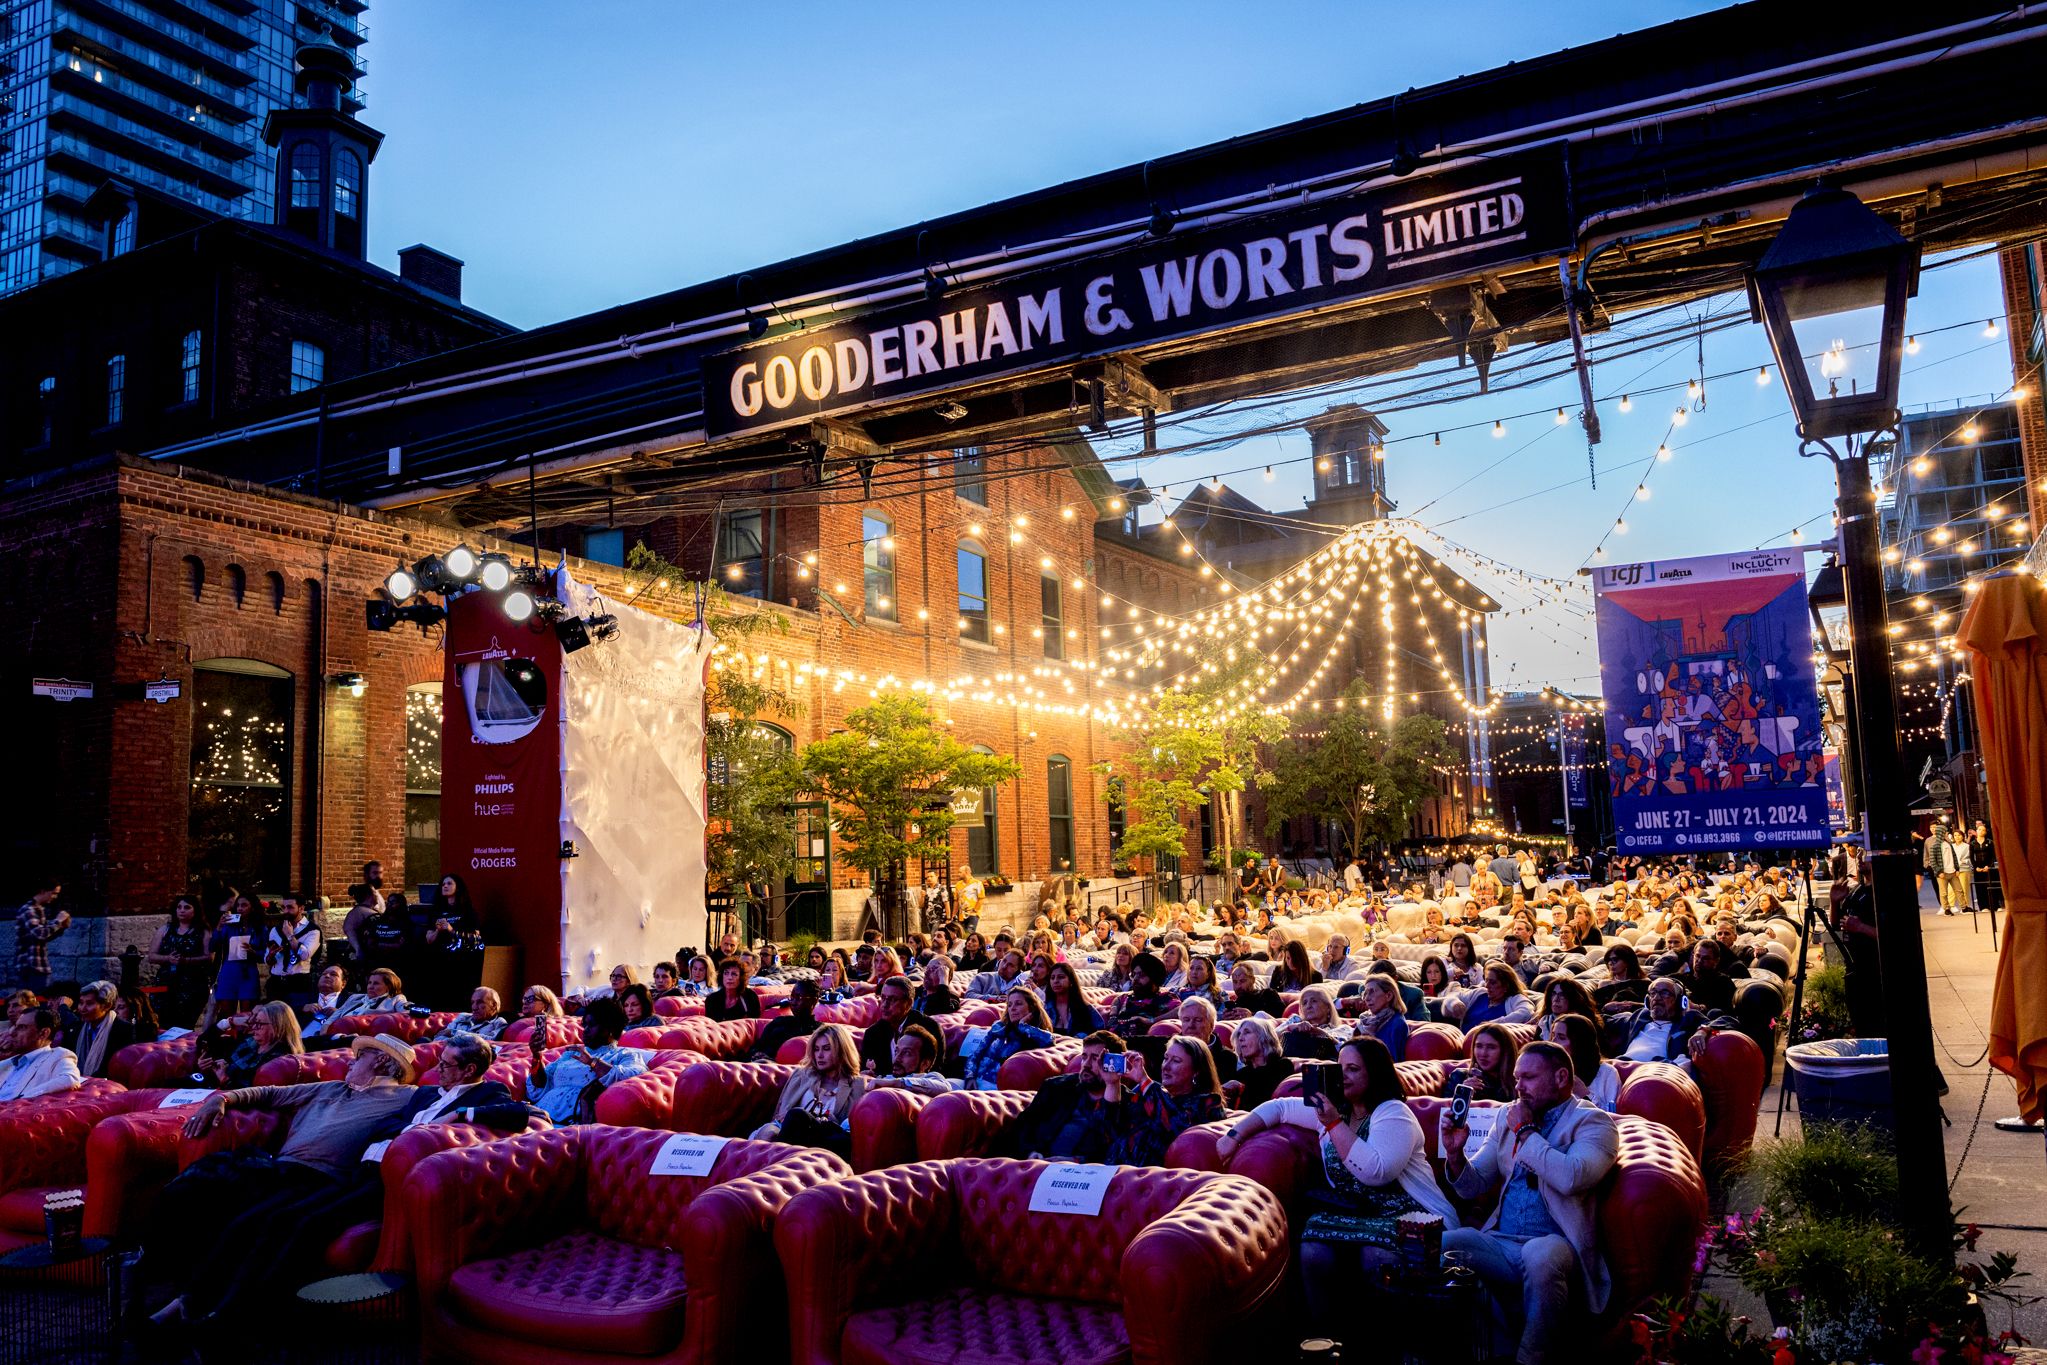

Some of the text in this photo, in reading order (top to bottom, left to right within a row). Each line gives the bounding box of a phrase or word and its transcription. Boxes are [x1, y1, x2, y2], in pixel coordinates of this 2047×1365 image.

[1383, 193, 1525, 257] LIMITED
[730, 214, 1374, 417] GOODERHAM & WORTS
[1610, 563, 1693, 585] icff LAVAZZA
[482, 649, 508, 660] LAVAZZA
[49, 687, 78, 696] TRINITY
[475, 783, 514, 794] PHILIPS
[474, 802, 501, 815] hue
[1635, 811, 1671, 830] JUNE
[1673, 810, 1690, 828] 27
[1705, 808, 1739, 827] JULY
[1743, 807, 1765, 826] 21,
[1768, 805, 1808, 825] 2024
[1688, 832, 1741, 844] 416.893.3966
[1767, 829, 1822, 842] @ICFFCANADA
[480, 857, 517, 868] ROGERS
[671, 1148, 705, 1157] RESERVED FOR
[1051, 1180, 1090, 1190] RESERVED FOR
